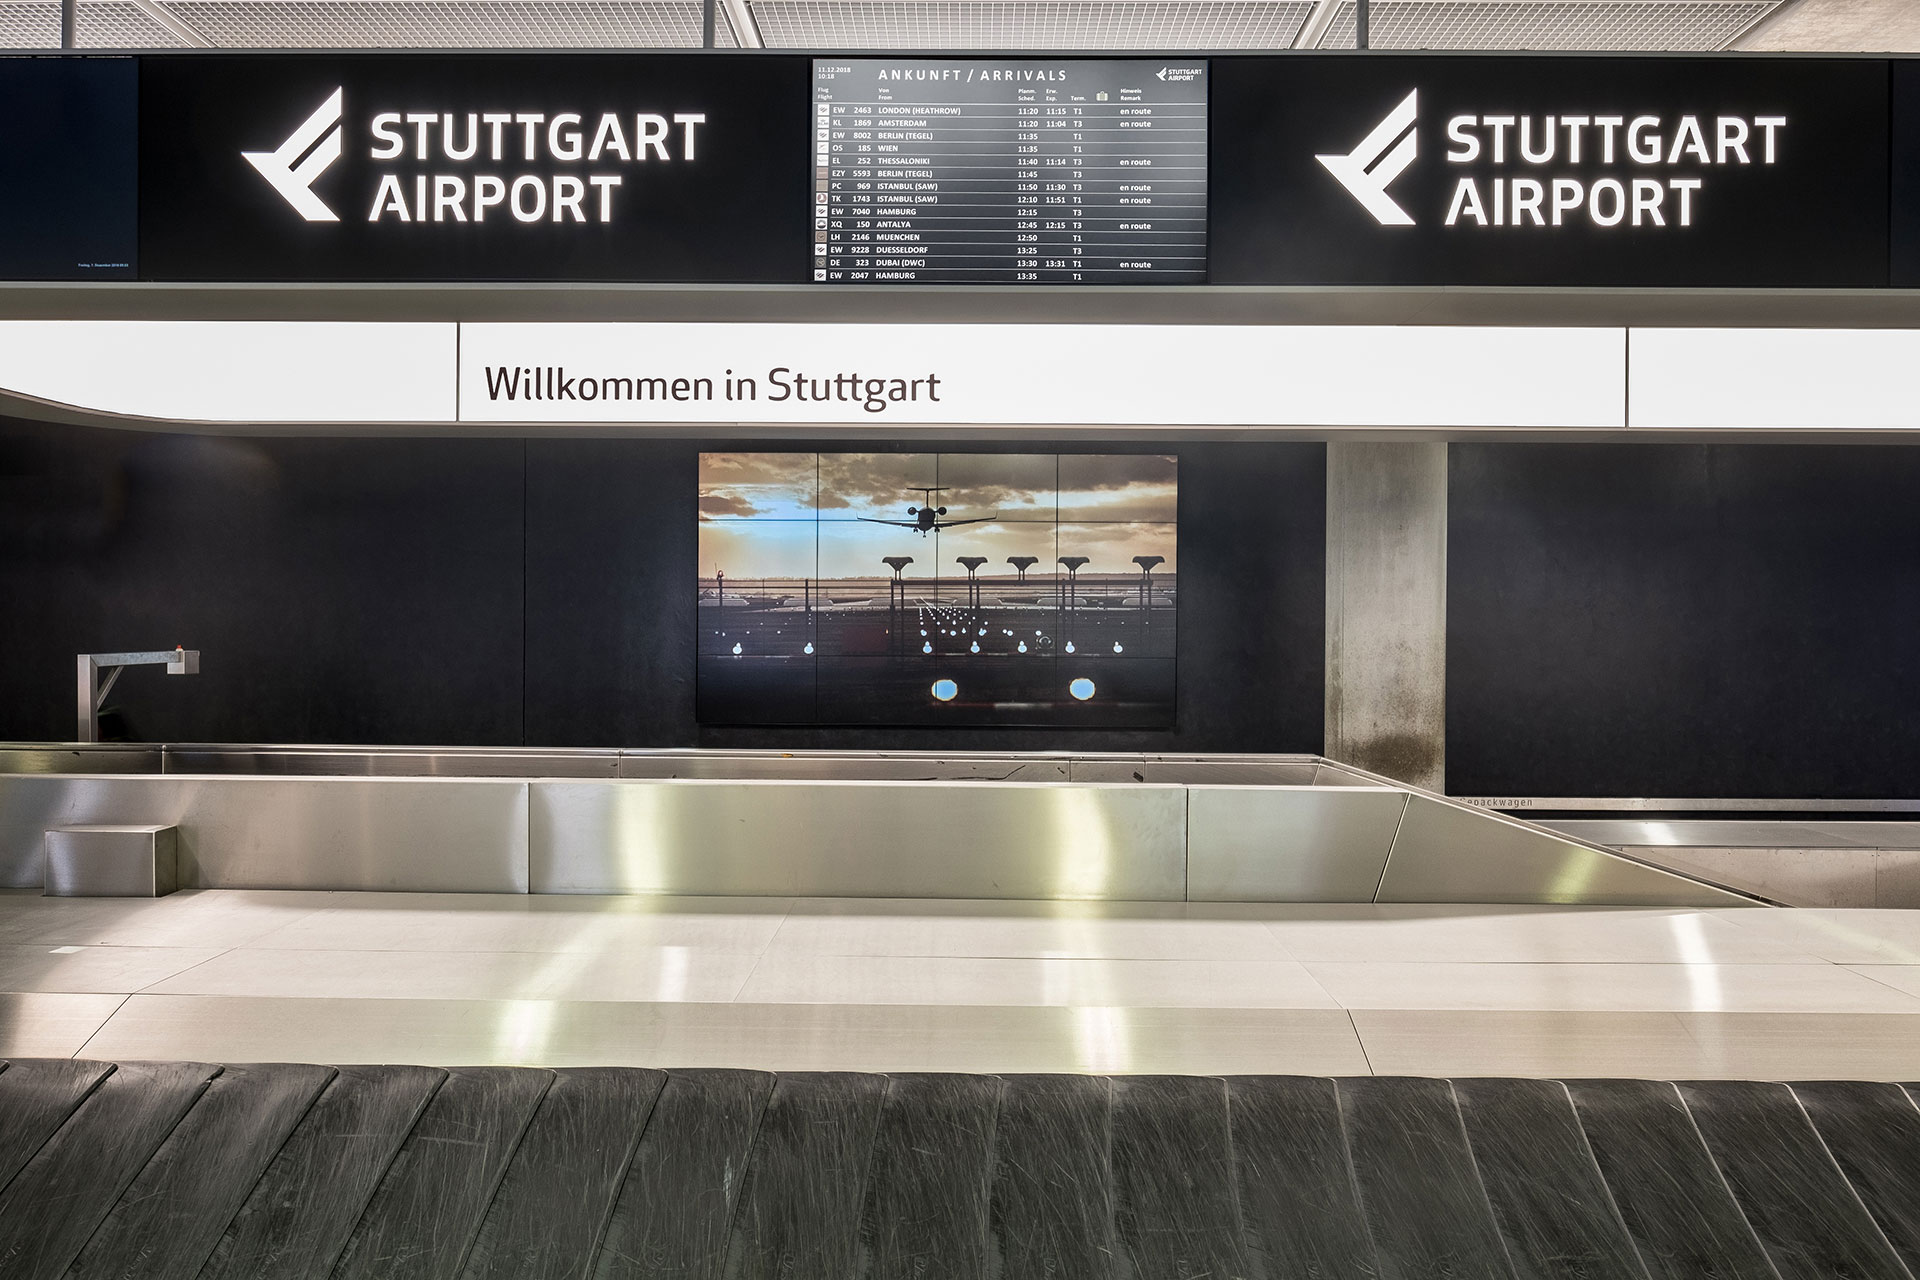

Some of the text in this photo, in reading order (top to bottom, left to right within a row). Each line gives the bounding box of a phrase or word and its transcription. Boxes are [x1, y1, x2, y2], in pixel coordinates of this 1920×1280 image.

[879, 69, 1065, 82] ANKUNFT / ARRIVALS
[913, 107, 960, 115] (HEATHROW)
[369, 112, 707, 161] STUTTGART
[906, 132, 932, 140] (TEGEL)
[1445, 114, 1787, 164] STUTTGART
[367, 174, 623, 223] AIRPORT
[915, 183, 937, 191] (SAW)
[1444, 177, 1702, 226] AIRPORT
[902, 259, 925, 267] (DWC)
[484, 366, 941, 413] Willkommen in Stuttgart
